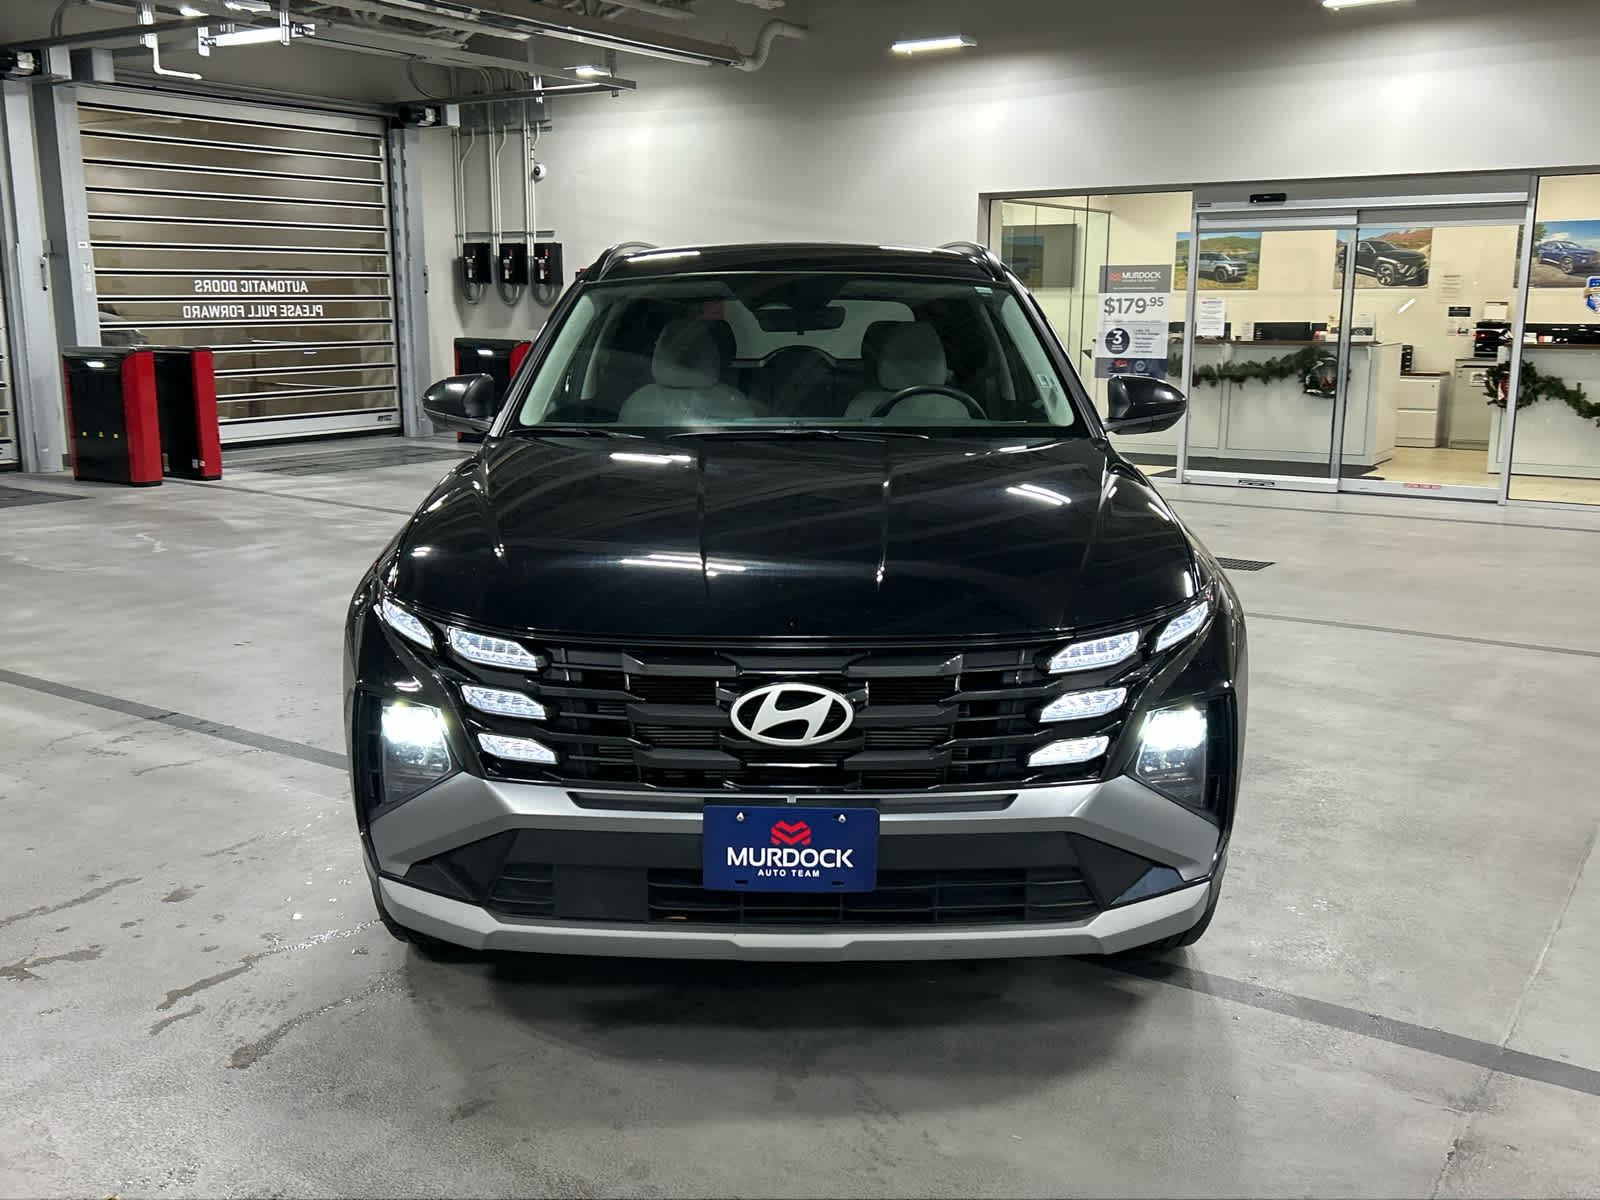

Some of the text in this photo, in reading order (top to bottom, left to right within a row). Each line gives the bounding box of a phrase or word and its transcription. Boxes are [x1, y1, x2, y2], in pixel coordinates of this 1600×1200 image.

[1121, 271, 1161, 279] MURDOCK
[1104, 297, 1164, 316] $179.95
[727, 847, 854, 868] MURDOCK
[757, 869, 820, 878] AUTO TEAM
